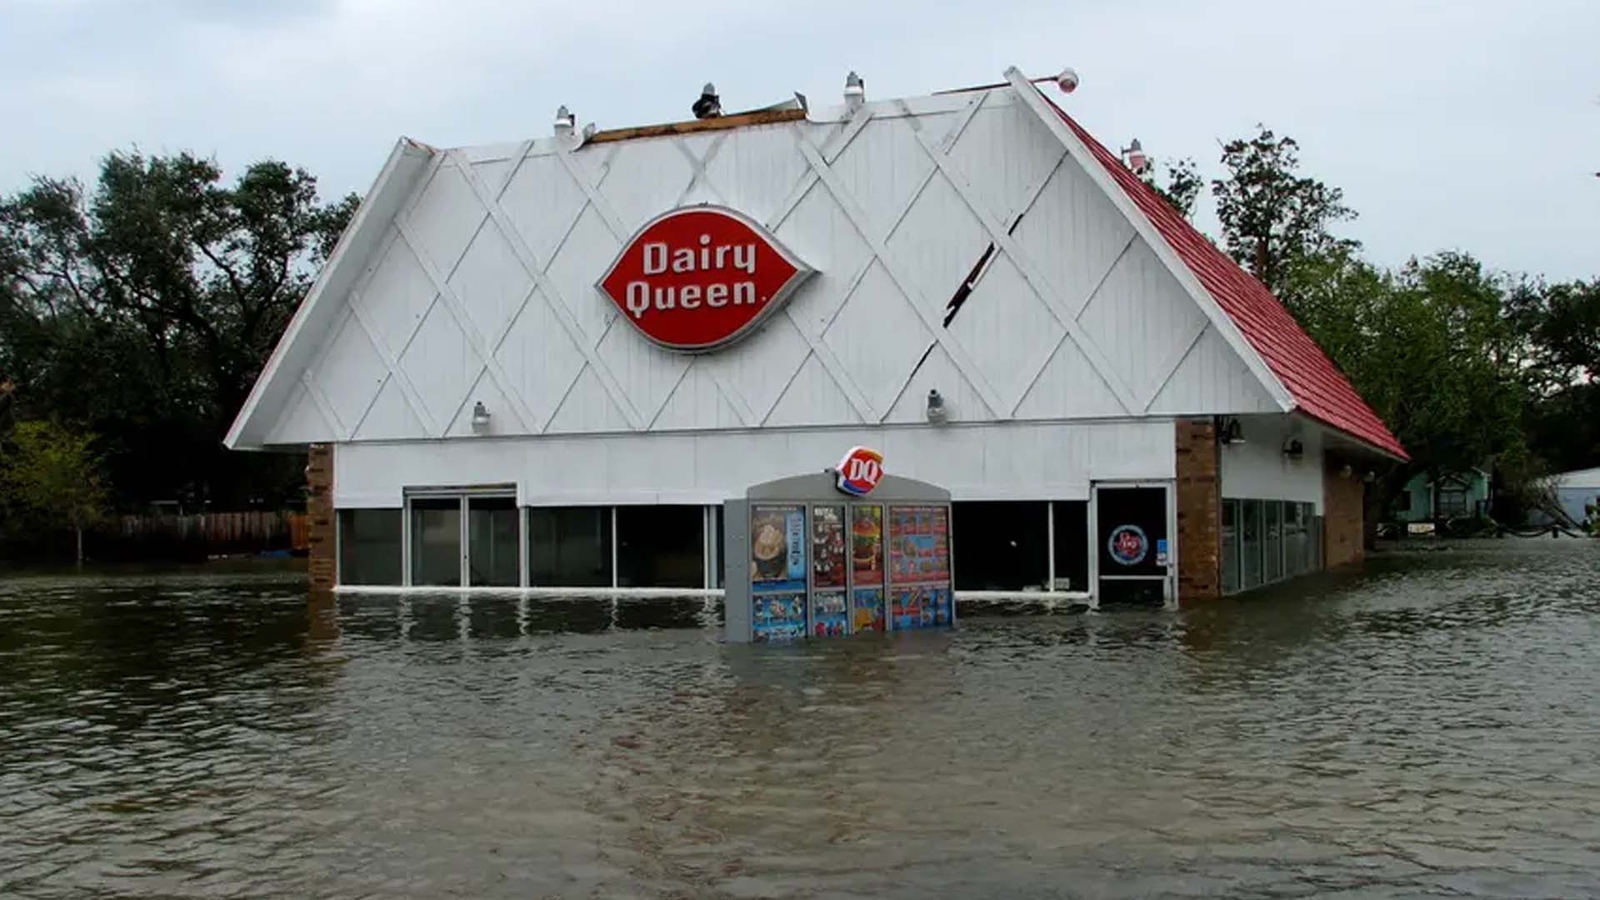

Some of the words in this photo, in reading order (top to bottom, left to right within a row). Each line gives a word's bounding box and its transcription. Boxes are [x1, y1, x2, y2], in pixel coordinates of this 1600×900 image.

[643, 234, 756, 274] Dairy
[626, 281, 755, 319] Queen
[849, 458, 878, 486] DQ
